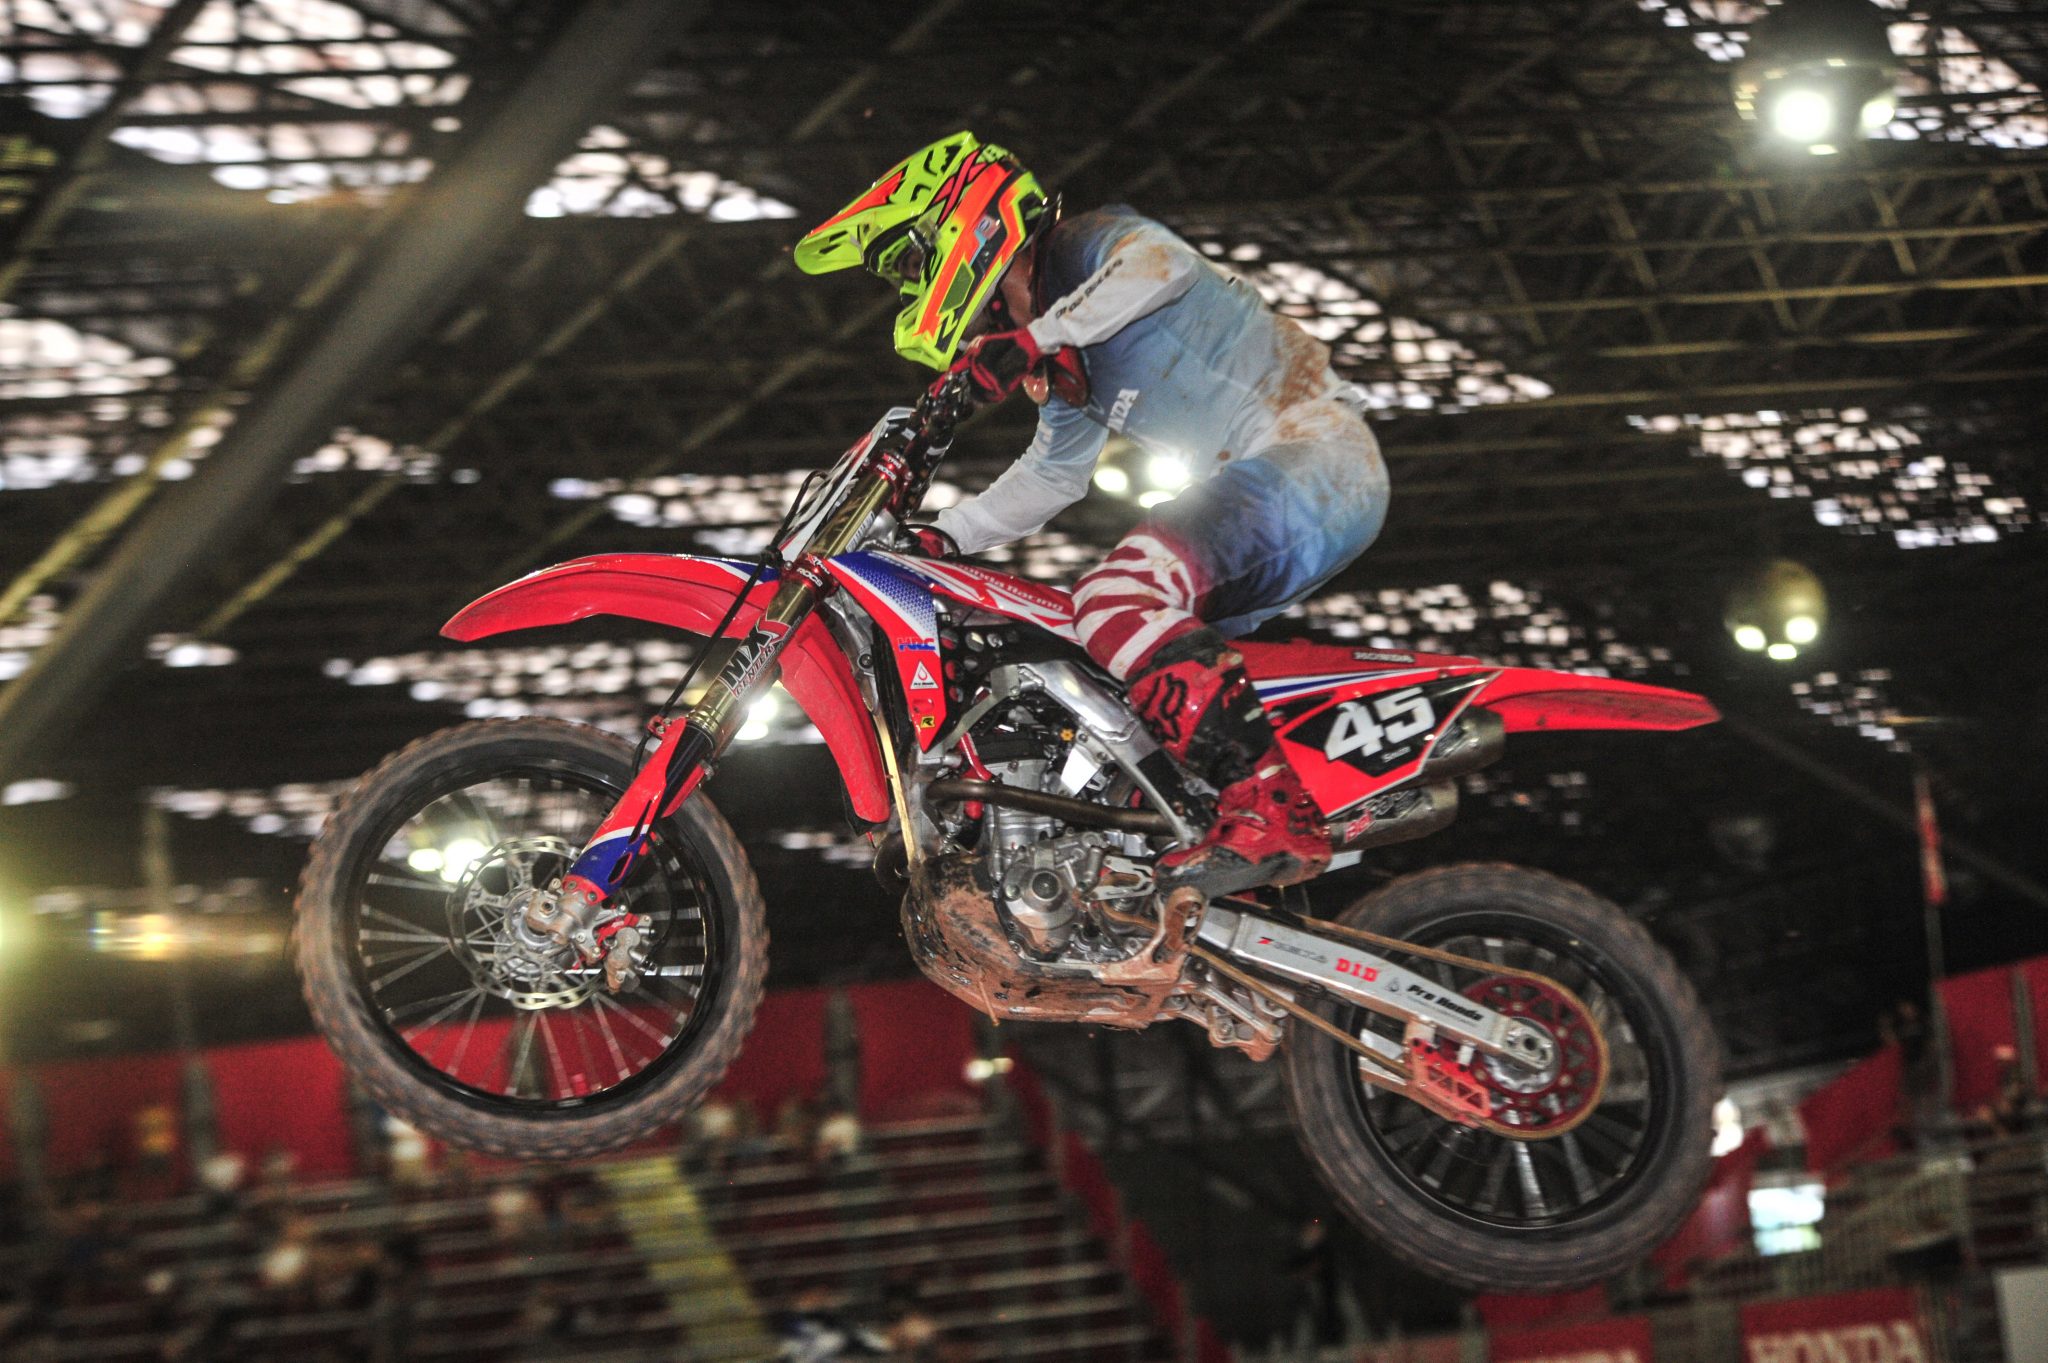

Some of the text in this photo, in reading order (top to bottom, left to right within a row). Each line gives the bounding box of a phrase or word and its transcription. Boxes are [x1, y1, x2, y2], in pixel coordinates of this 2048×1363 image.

[897, 636, 936, 652] HRC
[1324, 686, 1436, 761] 45
[1407, 984, 1437, 1001] Pro
[1435, 997, 1485, 1021] Honda
